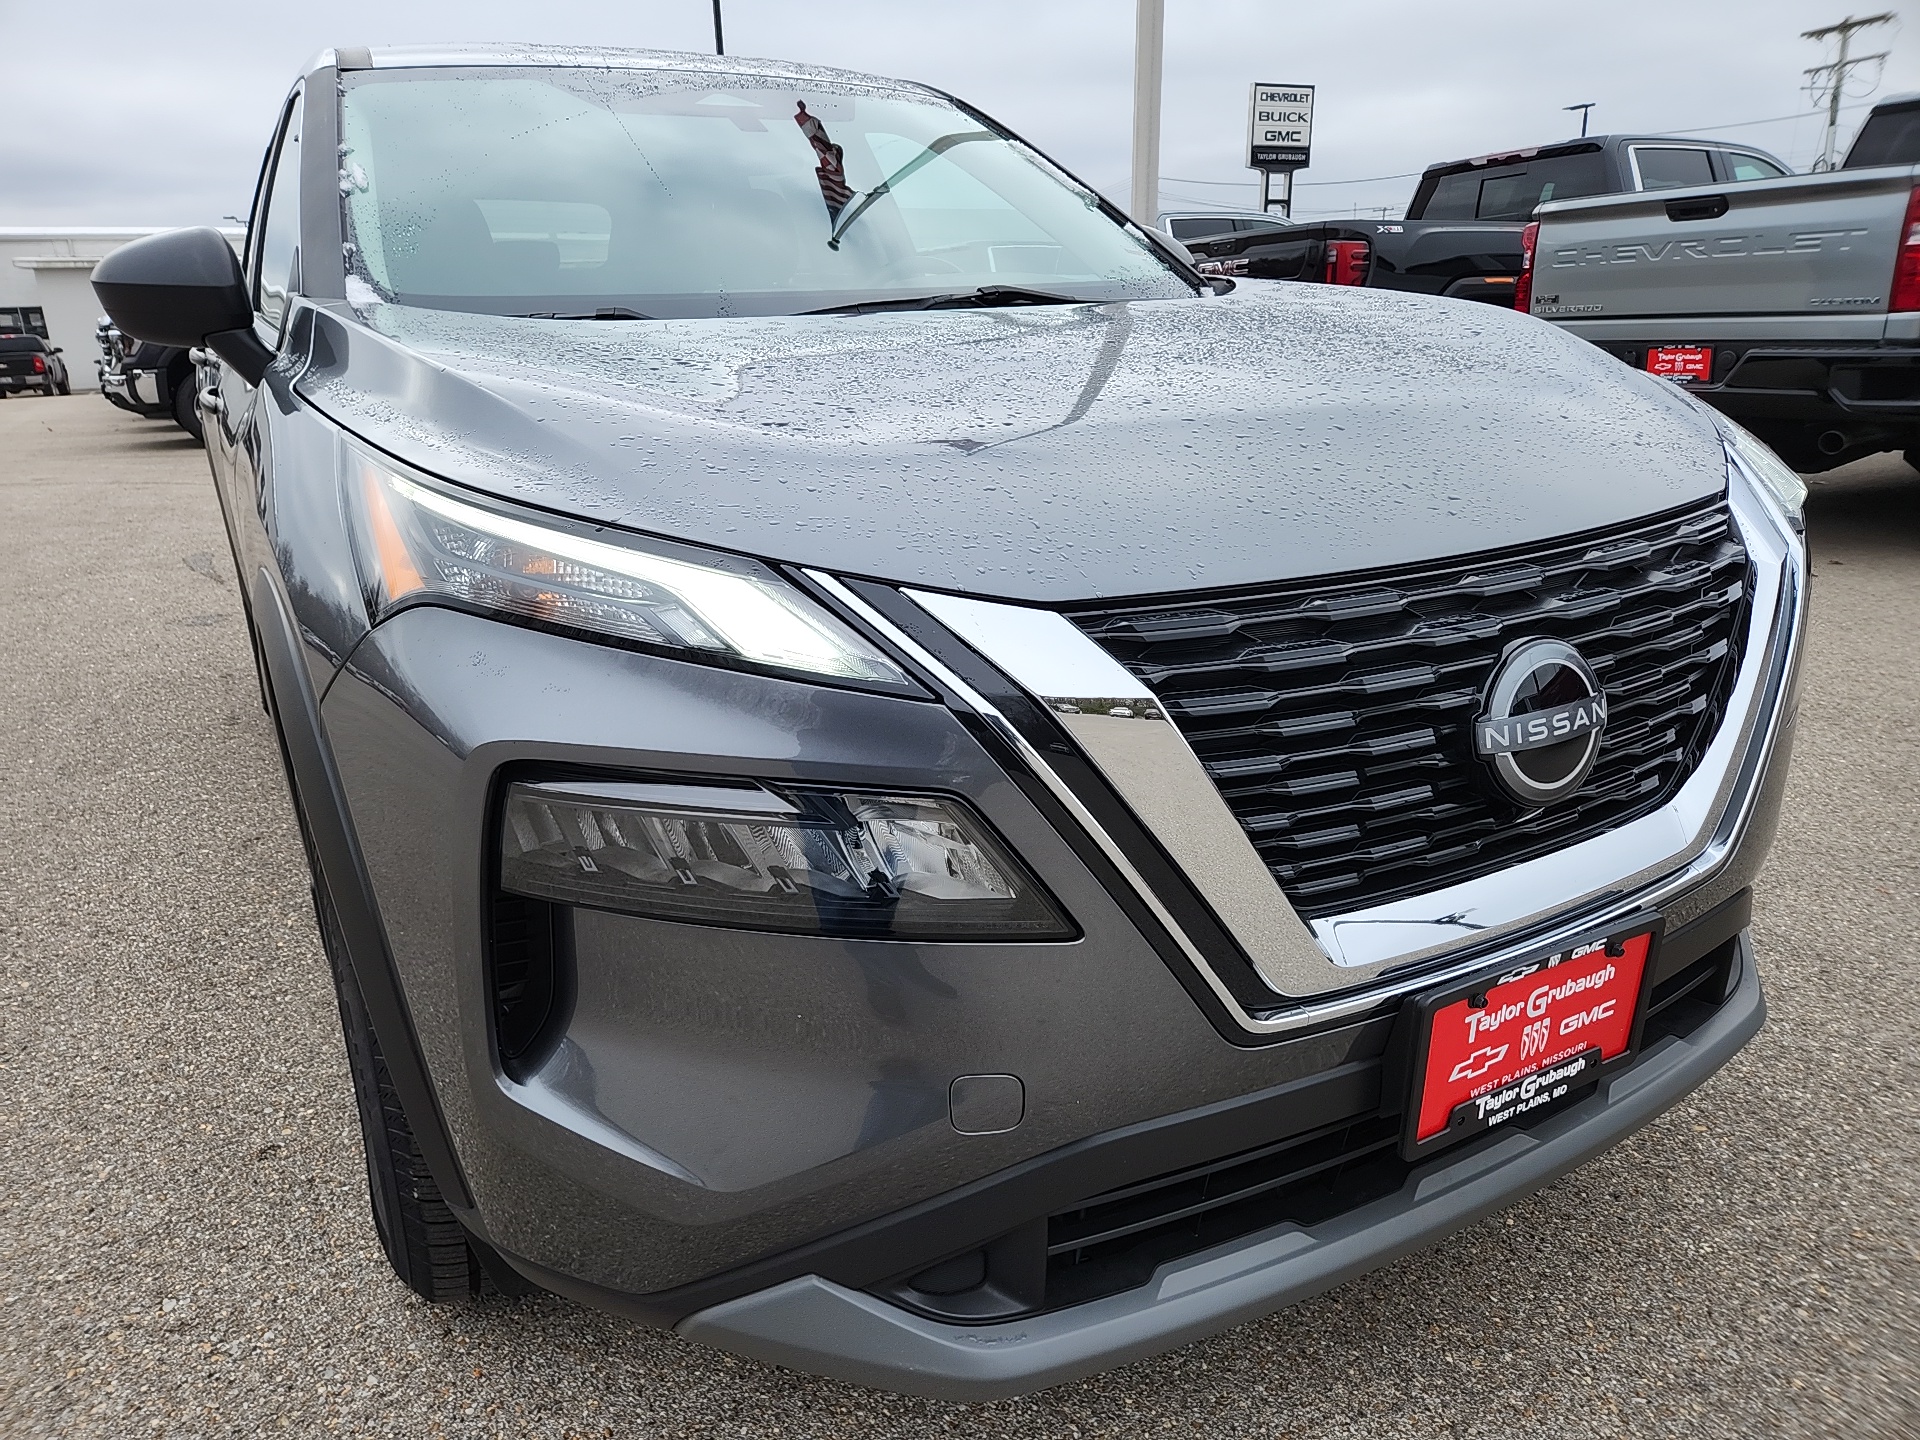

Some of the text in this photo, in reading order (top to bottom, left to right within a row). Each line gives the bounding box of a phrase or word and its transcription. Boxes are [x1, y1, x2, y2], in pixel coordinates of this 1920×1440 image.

[1260, 92, 1310, 103] CHEVROLET
[1259, 111, 1308, 123] BUICK
[1264, 131, 1301, 142] GMC
[1552, 229, 1868, 268] CHEVROLET
[1198, 259, 1249, 275] GMC
[1534, 304, 1603, 314] SILVERADO
[1810, 296, 1880, 306] CUSTOM
[1485, 699, 1606, 748] NISSAN
[1571, 938, 1607, 959] GMC
[1465, 964, 1616, 1044] Taylor Grubaugh
[1559, 999, 1616, 1036] GMC
[1470, 1041, 1587, 1099] WEST PLAINS, MISSOURI
[1476, 1058, 1586, 1119] Taylor Grubaugh
[1488, 1085, 1568, 1126] WEST PLAINS, MO
